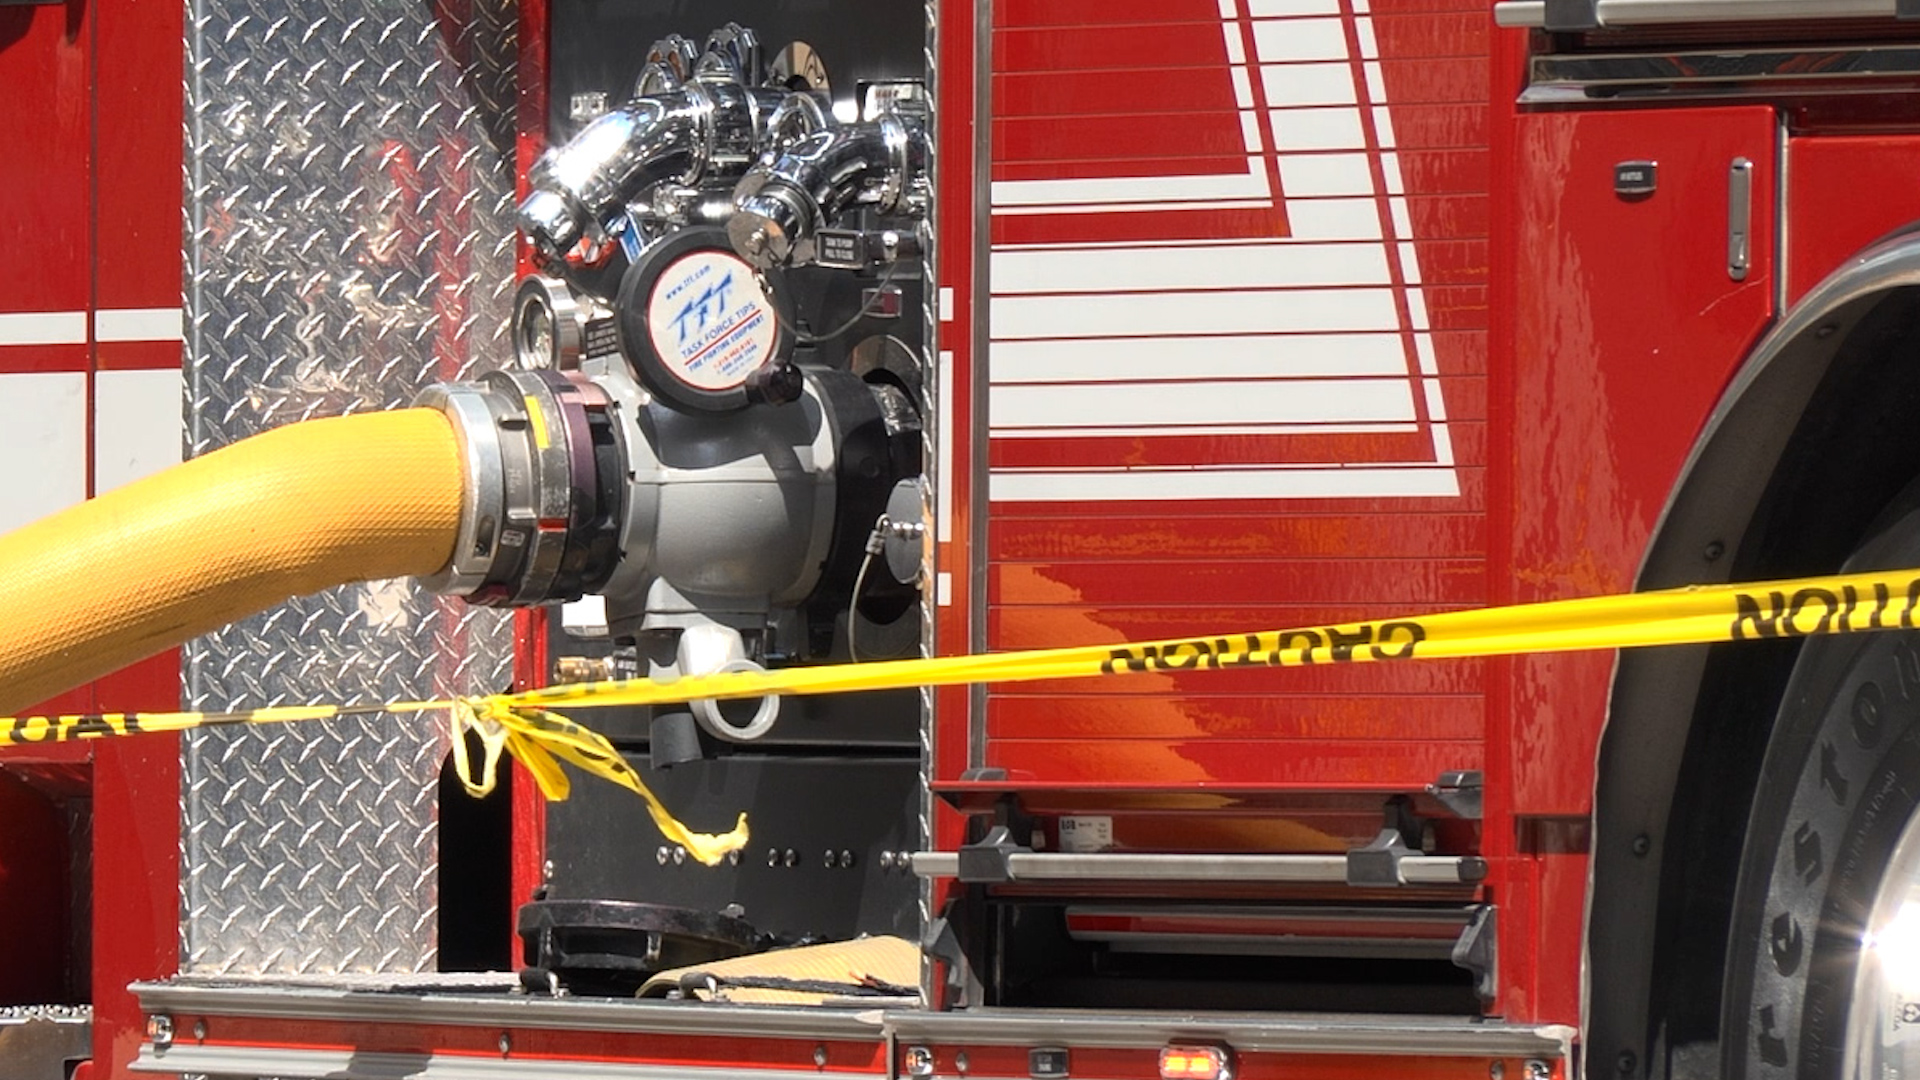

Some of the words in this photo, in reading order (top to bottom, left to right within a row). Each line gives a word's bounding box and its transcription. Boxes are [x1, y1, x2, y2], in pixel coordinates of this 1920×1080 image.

[667, 272, 732, 343] TFT
[682, 342, 704, 358] TASK
[705, 317, 733, 341] FORCE
[736, 302, 755, 319] TIPS
[704, 338, 730, 360] FIGHTING
[731, 315, 763, 342] EQUIPMENT
[1731, 579, 1920, 639] TION
[1101, 621, 1426, 674] CAUTION
